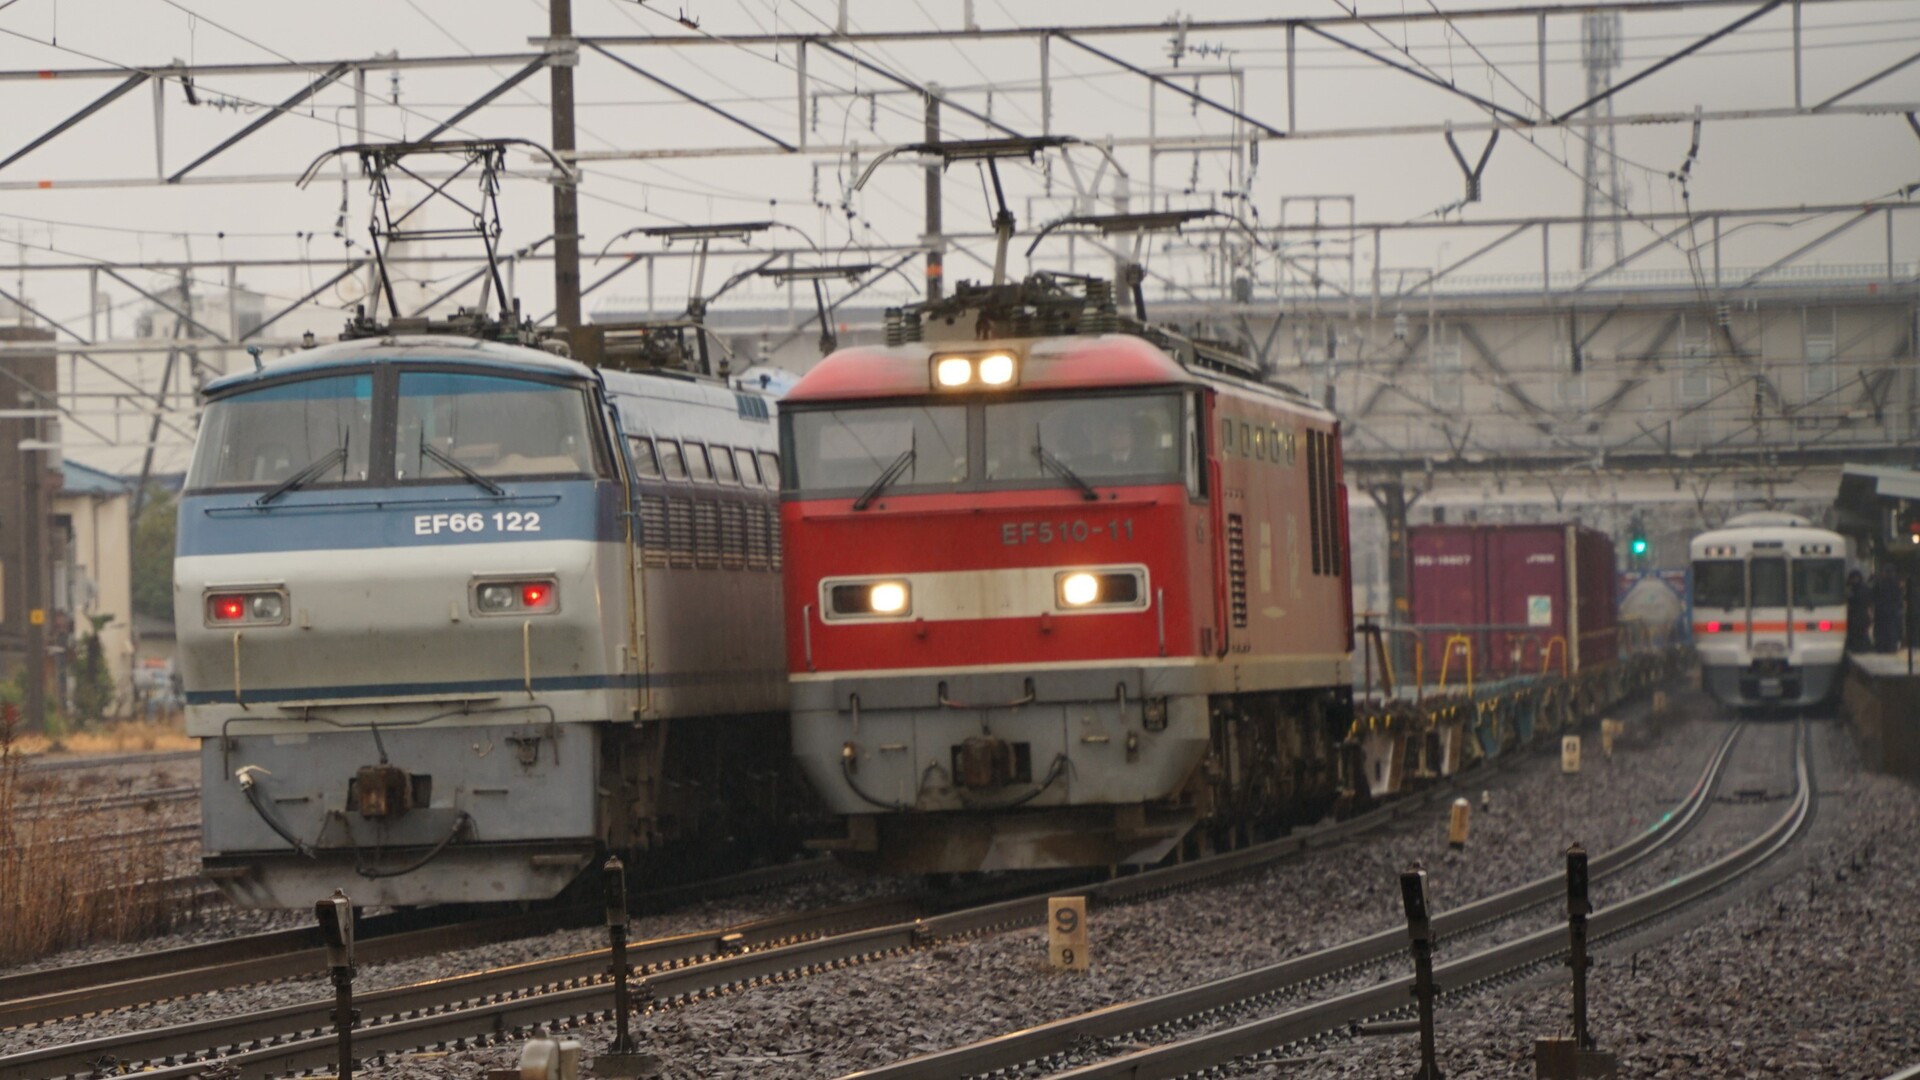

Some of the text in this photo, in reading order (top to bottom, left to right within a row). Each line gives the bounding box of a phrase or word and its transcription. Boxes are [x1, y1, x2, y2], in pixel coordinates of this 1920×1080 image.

[414, 512, 541, 535] EF66 122
[1002, 518, 1133, 544] EF510-11
[1056, 908, 1077, 933] 9
[1062, 949, 1074, 965] 9
